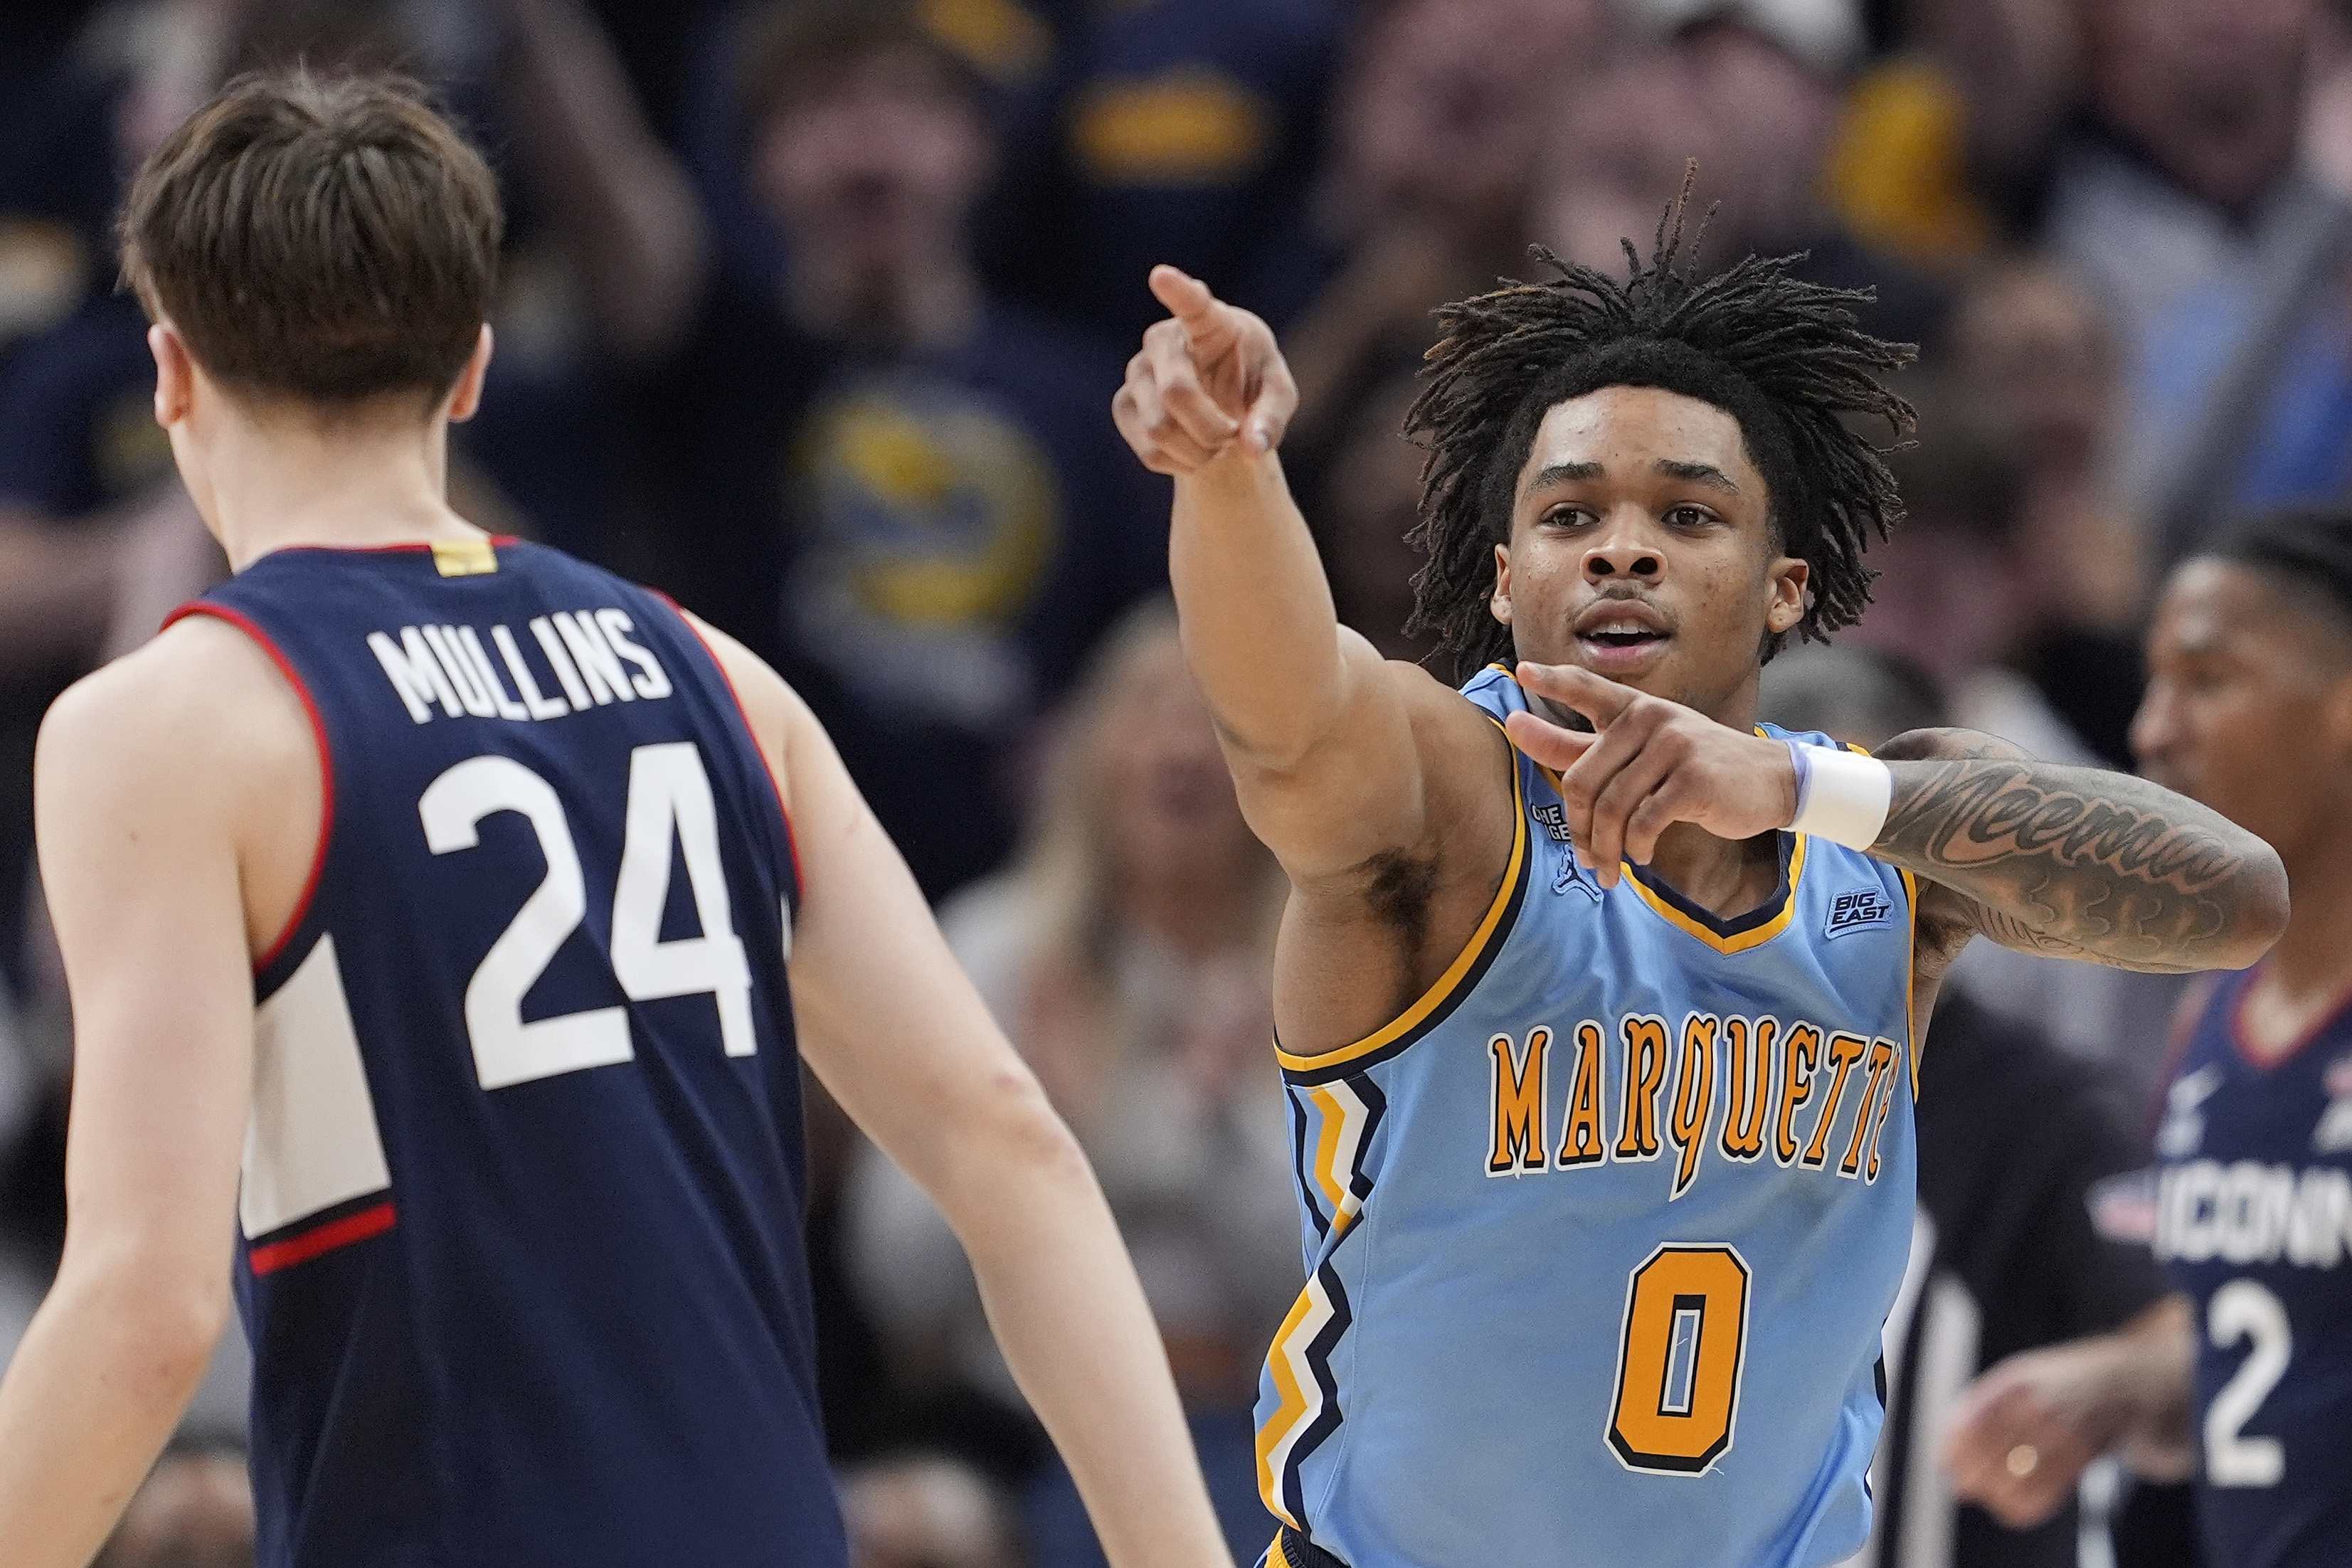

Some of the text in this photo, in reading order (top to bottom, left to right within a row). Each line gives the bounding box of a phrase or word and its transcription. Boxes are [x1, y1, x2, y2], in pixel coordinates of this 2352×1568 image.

[366, 608, 674, 724] MULLINS
[417, 741, 758, 1091] 24
[1831, 904, 1890, 926] EAST
[1834, 891, 1877, 911] BIG
[1603, 1241, 1753, 1478] 0
[2203, 1278, 2295, 1490] 2
